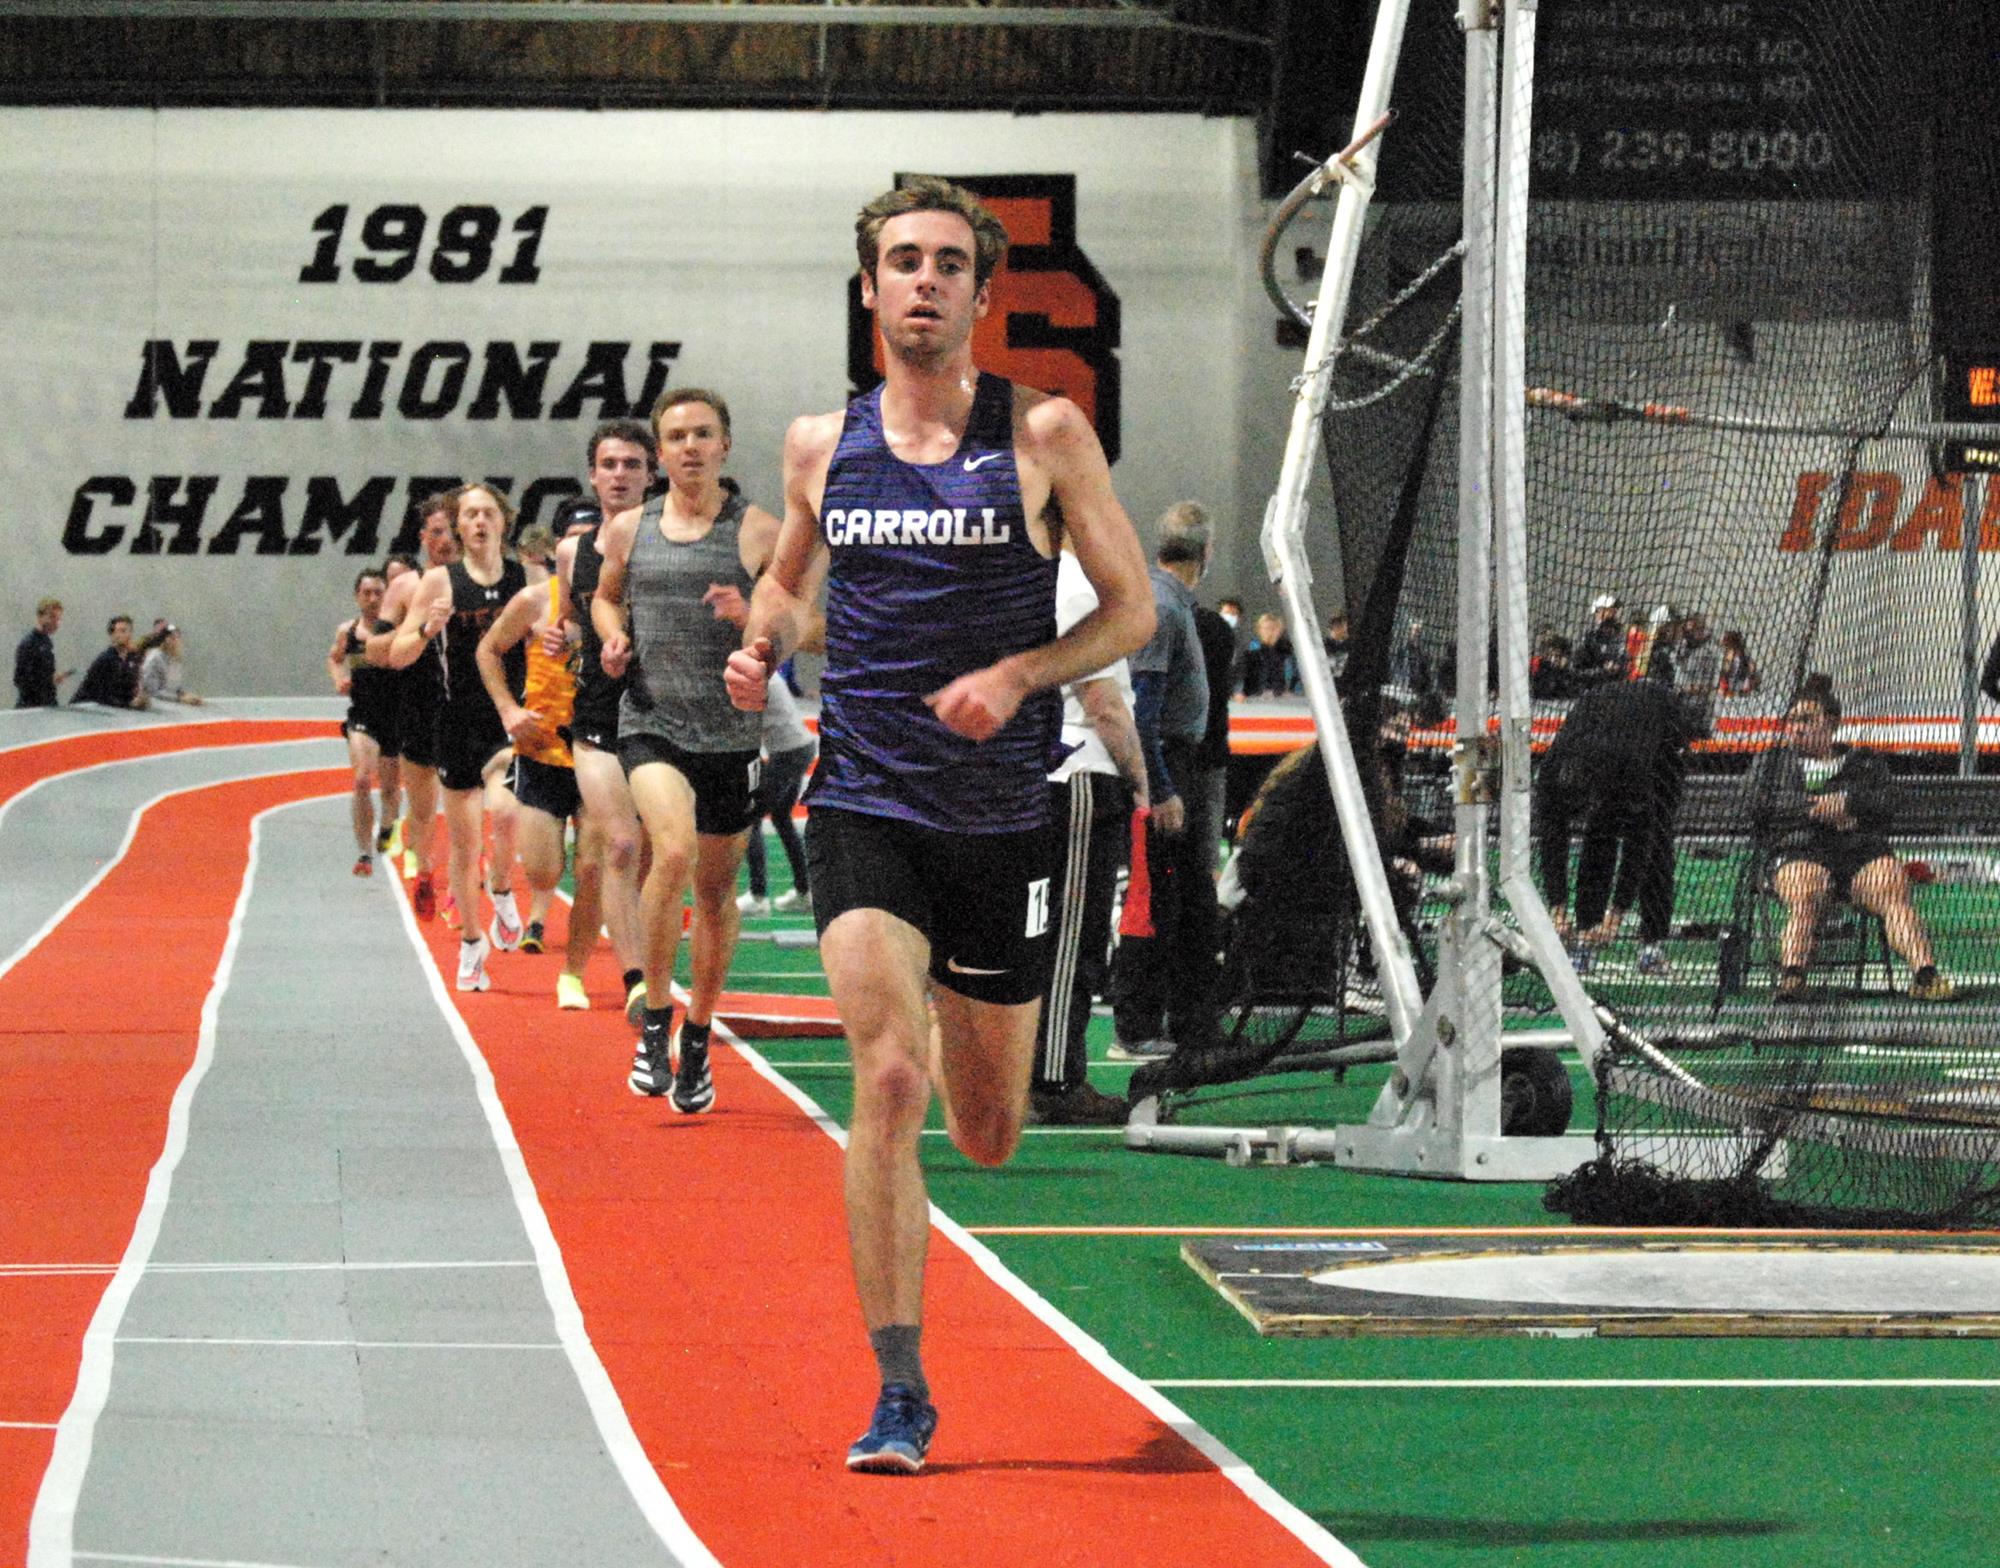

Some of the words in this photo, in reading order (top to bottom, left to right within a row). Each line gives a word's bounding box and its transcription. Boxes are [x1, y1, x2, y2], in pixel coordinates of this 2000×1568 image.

[299, 204, 549, 283] 1981
[825, 508, 1010, 546] CARROLL
[1778, 471, 2000, 553] IDA
